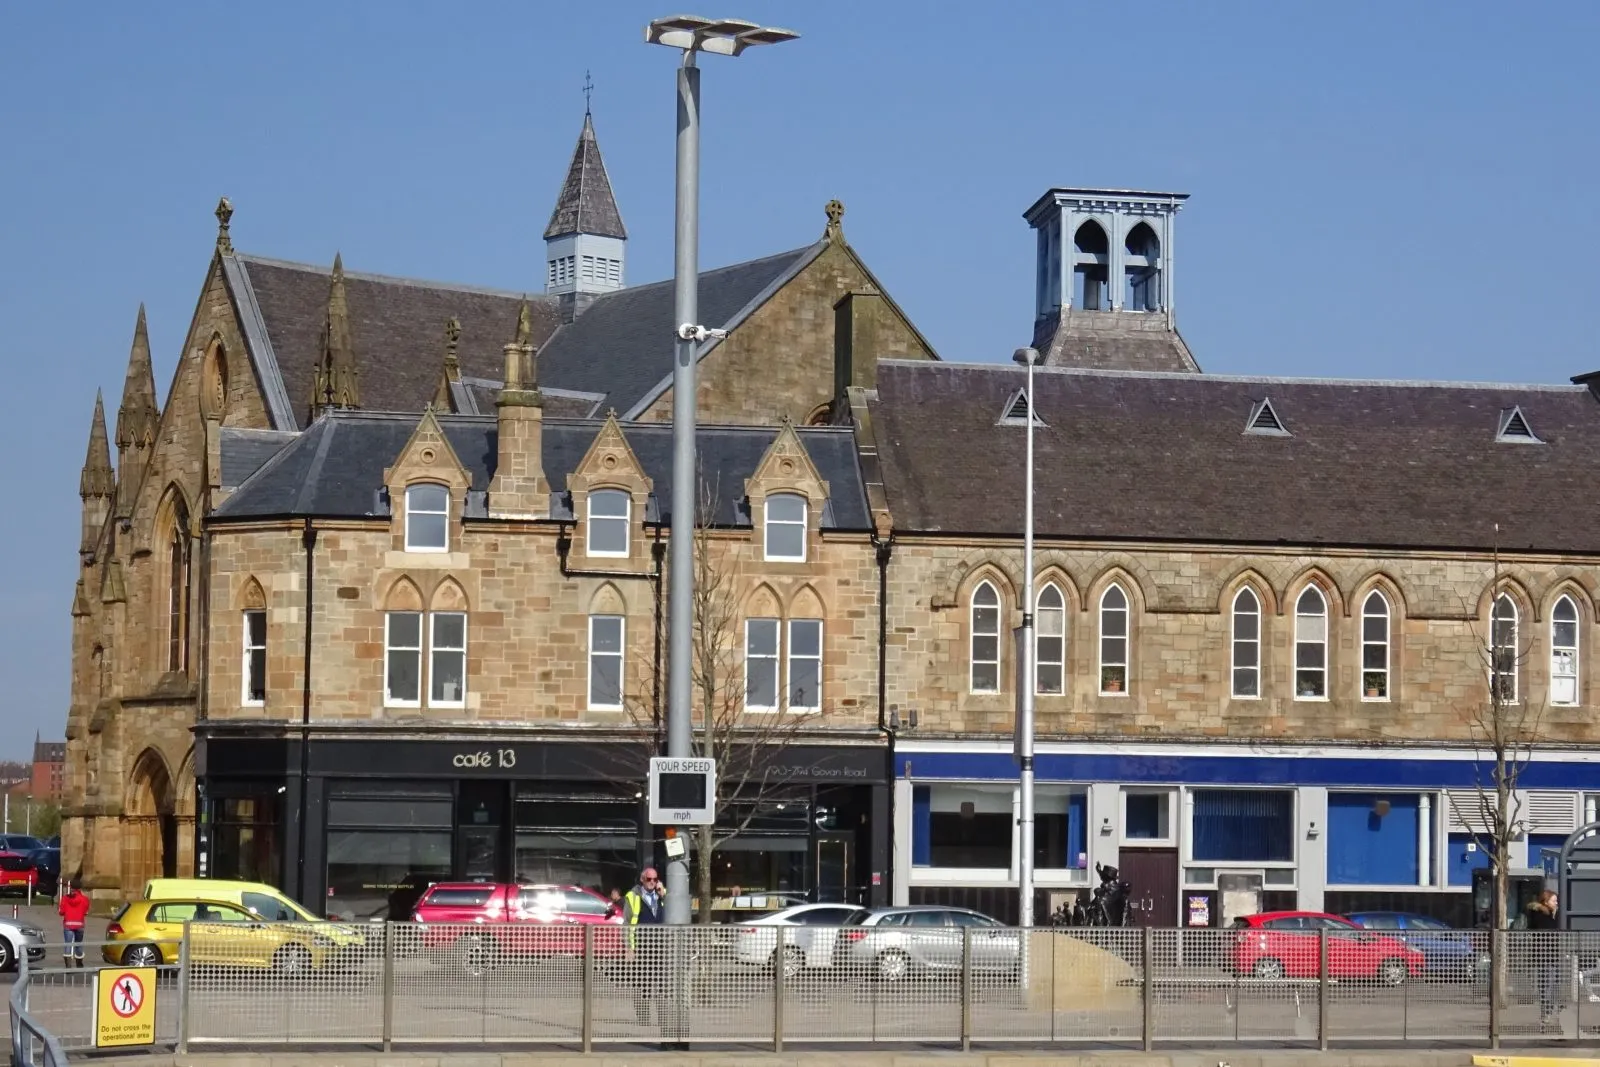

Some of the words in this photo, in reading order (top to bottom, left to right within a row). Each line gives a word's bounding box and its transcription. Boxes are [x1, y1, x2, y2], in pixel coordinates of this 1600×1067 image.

[452, 751, 492, 768] café
[497, 749, 517, 768] 13
[655, 761, 680, 772] YOUR
[681, 761, 711, 772] SPEED
[811, 765, 842, 777] Govan
[843, 766, 867, 777] Road
[673, 811, 692, 822] mph
[101, 1025, 110, 1033] Do
[112, 1024, 122, 1032] not
[102, 1033, 136, 1041] operational
